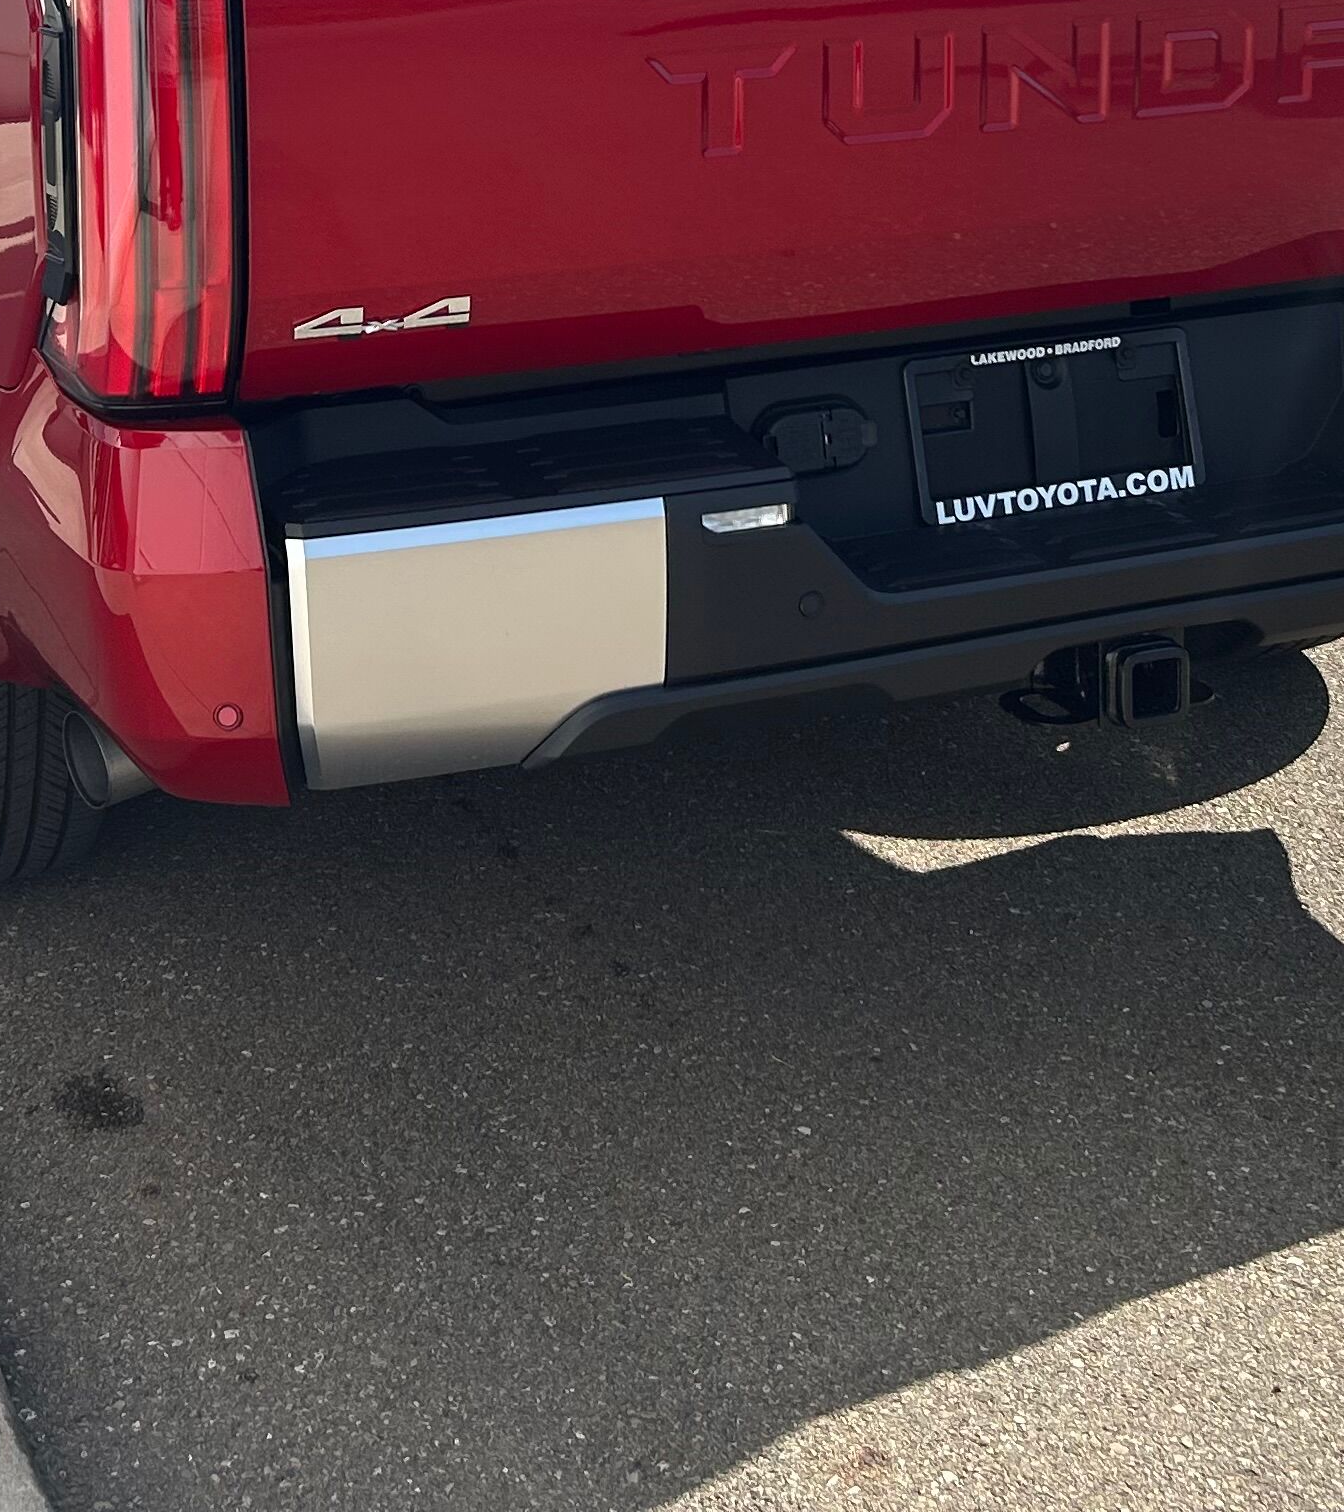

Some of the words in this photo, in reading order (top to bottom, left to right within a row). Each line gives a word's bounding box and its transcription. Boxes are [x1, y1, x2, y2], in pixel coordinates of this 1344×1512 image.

[293, 295, 472, 340] 4x4
[970, 346, 1046, 366] LAKEWOOD
[1054, 336, 1122, 356] BRADFORD
[935, 464, 1197, 526] LUVTOYOTA.COM
